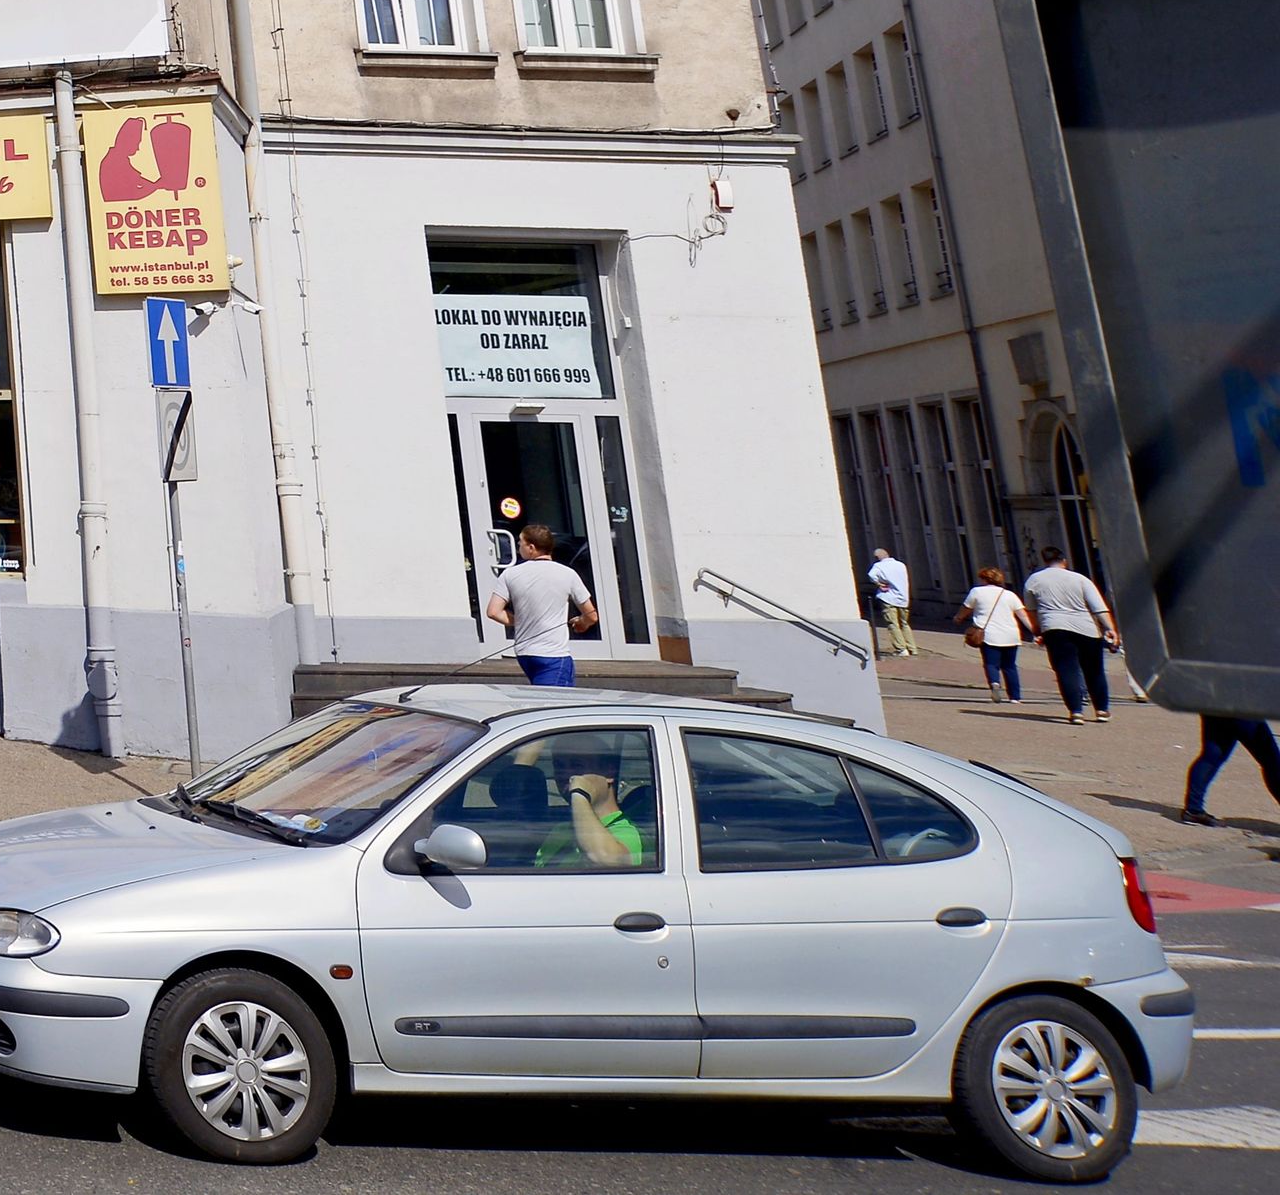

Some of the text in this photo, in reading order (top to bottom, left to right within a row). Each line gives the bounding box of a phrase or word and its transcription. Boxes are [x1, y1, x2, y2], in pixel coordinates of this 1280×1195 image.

[105, 207, 202, 230] DÖNER
[109, 260, 209, 274] www.istanbul.pl
[110, 274, 214, 287] tel. 58 55 666 33
[435, 308, 587, 330] LOKAL DO WYNAJĘCIA
[480, 332, 549, 350] OD ZARAZ
[477, 367, 504, 383] +48
[506, 367, 531, 383] 601
[534, 368, 562, 384] 666
[564, 368, 591, 384] 999
